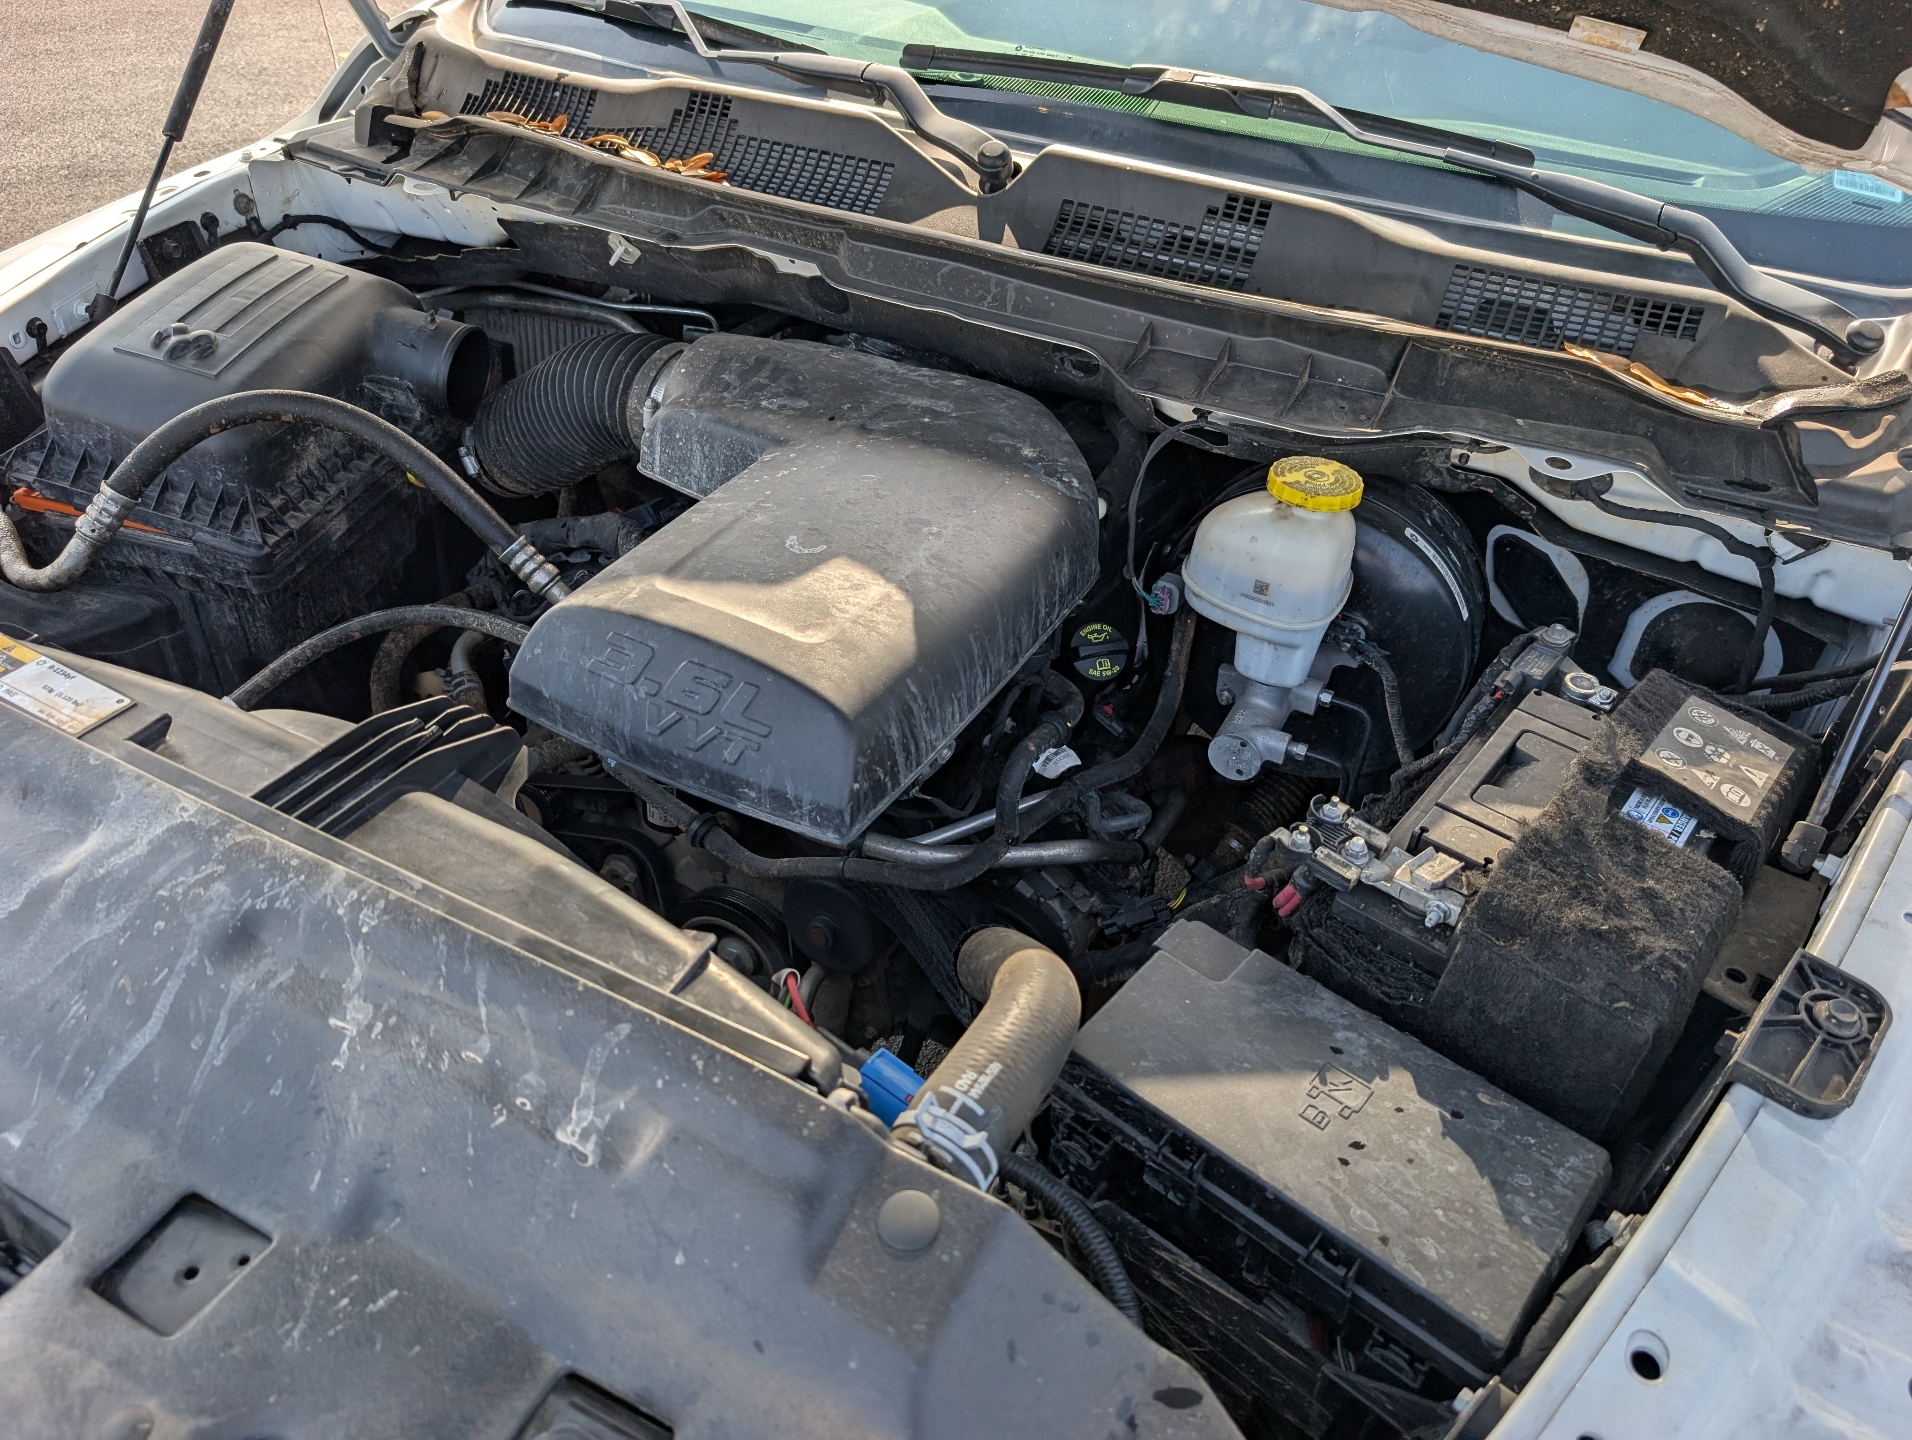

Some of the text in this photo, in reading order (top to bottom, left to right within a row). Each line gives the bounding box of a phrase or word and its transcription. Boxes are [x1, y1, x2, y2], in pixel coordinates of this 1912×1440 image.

[1079, 623, 1113, 637] ENGINE OIL
[47, 664, 77, 680] R-1234yf
[1088, 665, 1120, 677] SAE 5W-20
[587, 631, 773, 739] 3.6L
[645, 700, 761, 767] VVT
[1674, 813, 1691, 833] ANGER
